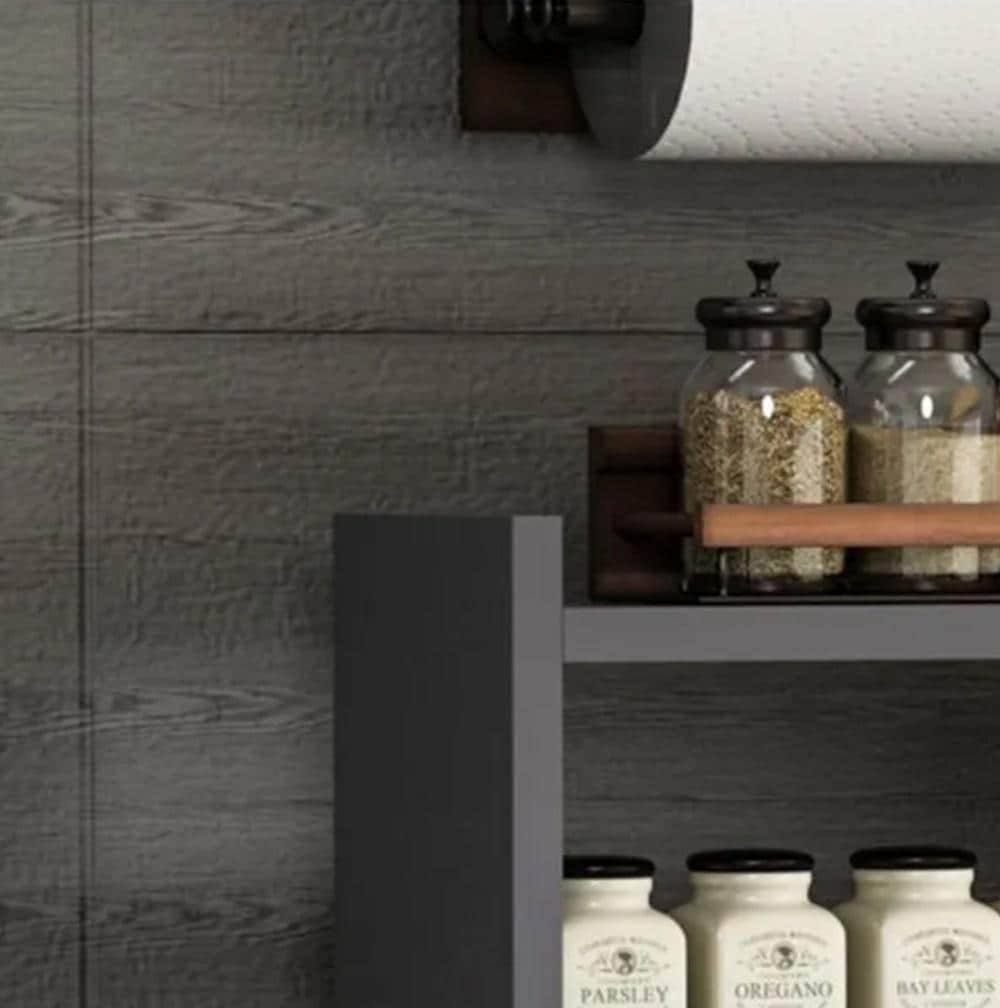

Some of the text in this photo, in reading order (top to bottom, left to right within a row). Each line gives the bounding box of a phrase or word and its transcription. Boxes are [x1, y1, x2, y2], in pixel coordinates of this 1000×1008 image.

[580, 986, 670, 1004] PARSLEY
[734, 981, 834, 1000] OREGANO
[896, 979, 996, 996] BAY LEAVES
